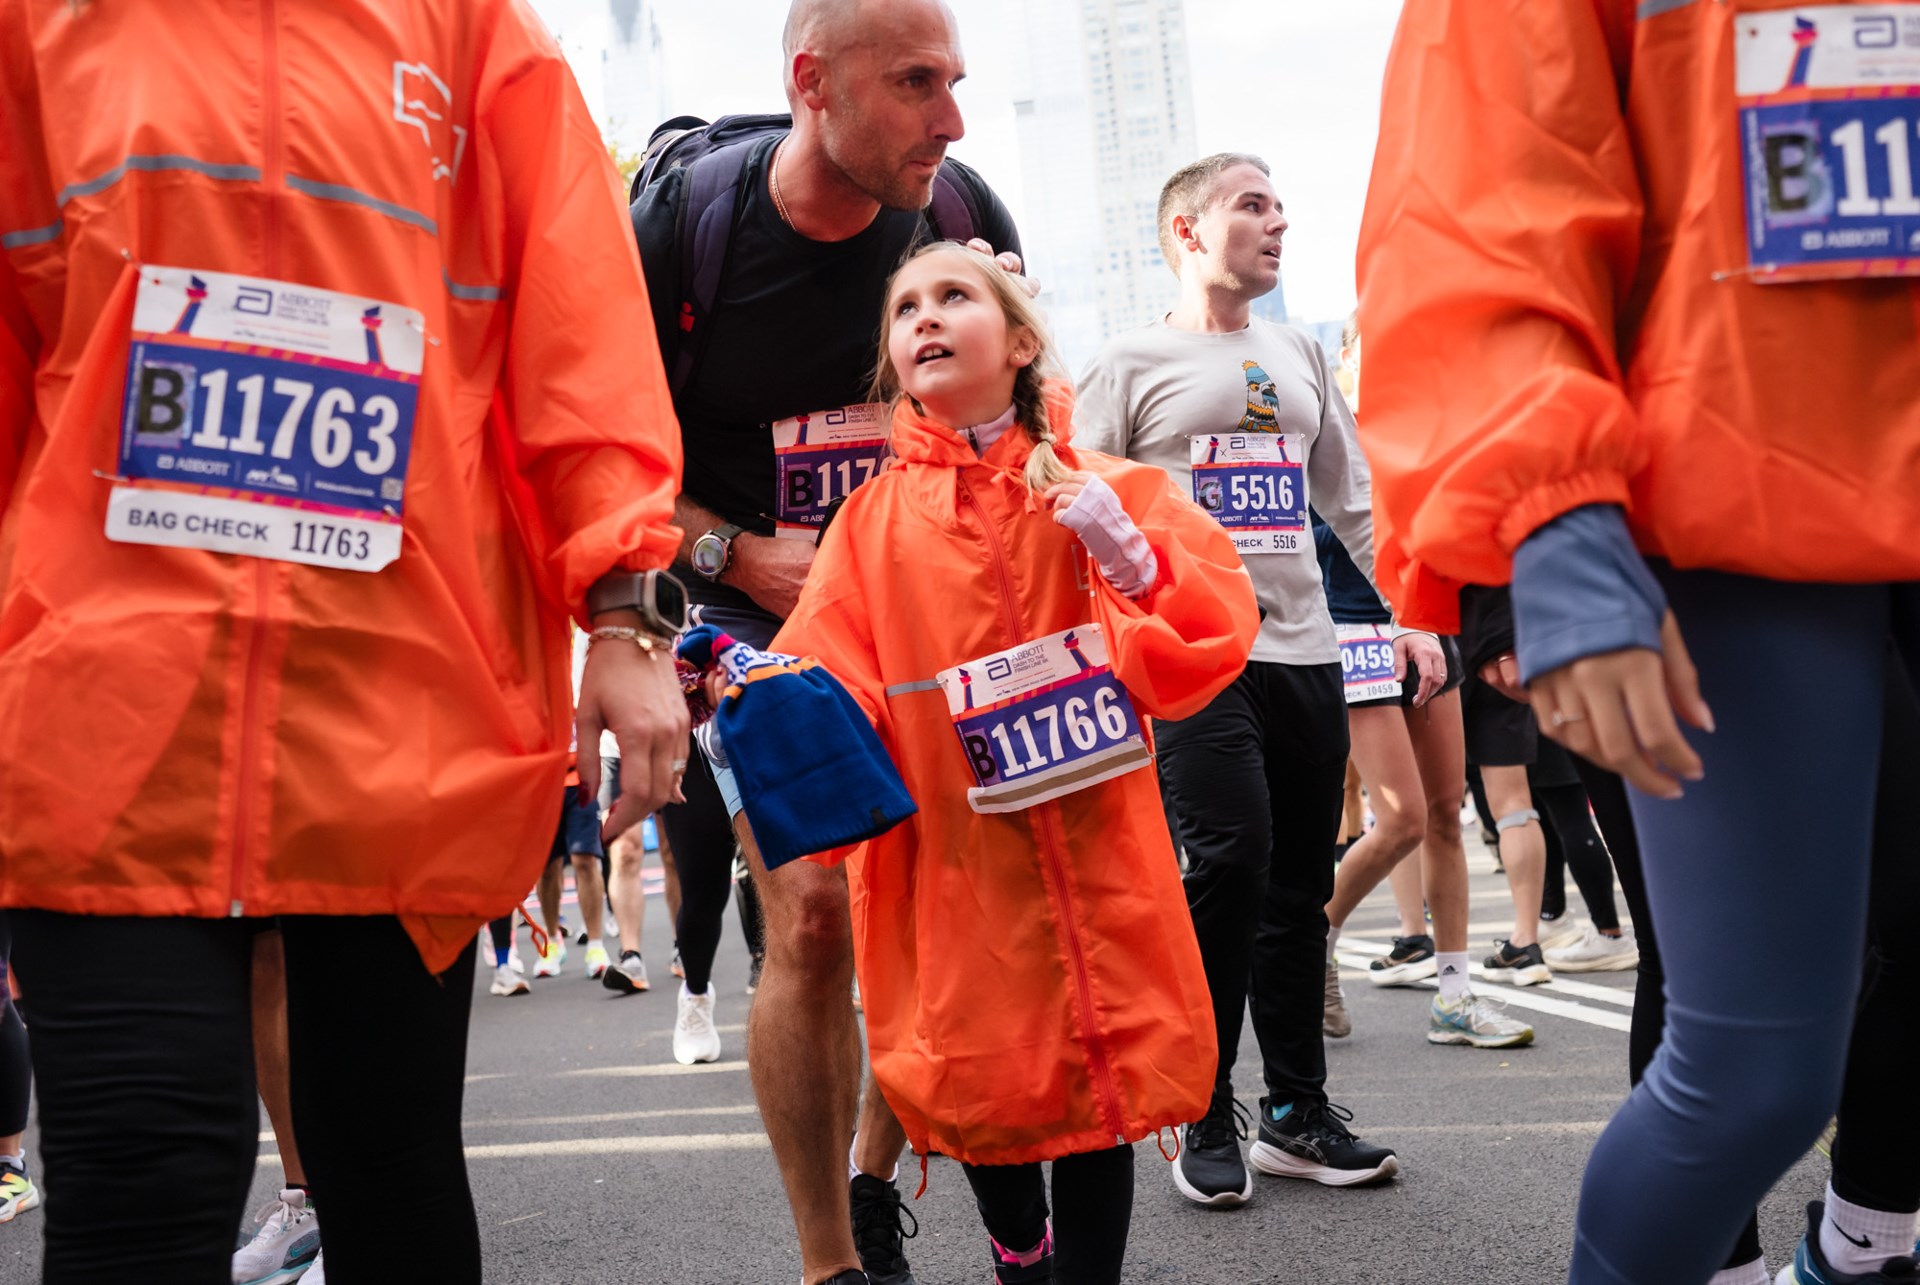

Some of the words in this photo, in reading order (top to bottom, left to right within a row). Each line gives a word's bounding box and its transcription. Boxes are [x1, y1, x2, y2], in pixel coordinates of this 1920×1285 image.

[1764, 134, 1826, 214] B
[1831, 118, 1920, 217] 11
[136, 366, 185, 435] B
[192, 368, 399, 476] 11763
[788, 469, 813, 508] B
[1200, 481, 1223, 511] G
[1231, 474, 1294, 511] 5516
[128, 508, 177, 530] BAG
[184, 515, 269, 541] CHECK
[289, 520, 371, 561] 11763
[1273, 534, 1297, 549] 5516
[1011, 643, 1045, 663] ABBOTT
[1012, 659, 1028, 669] DASH
[1035, 653, 1045, 661] THE
[1014, 664, 1031, 674] FINISH
[1367, 683, 1394, 697] 10459
[965, 734, 997, 780] B
[990, 686, 1128, 779] 11766
